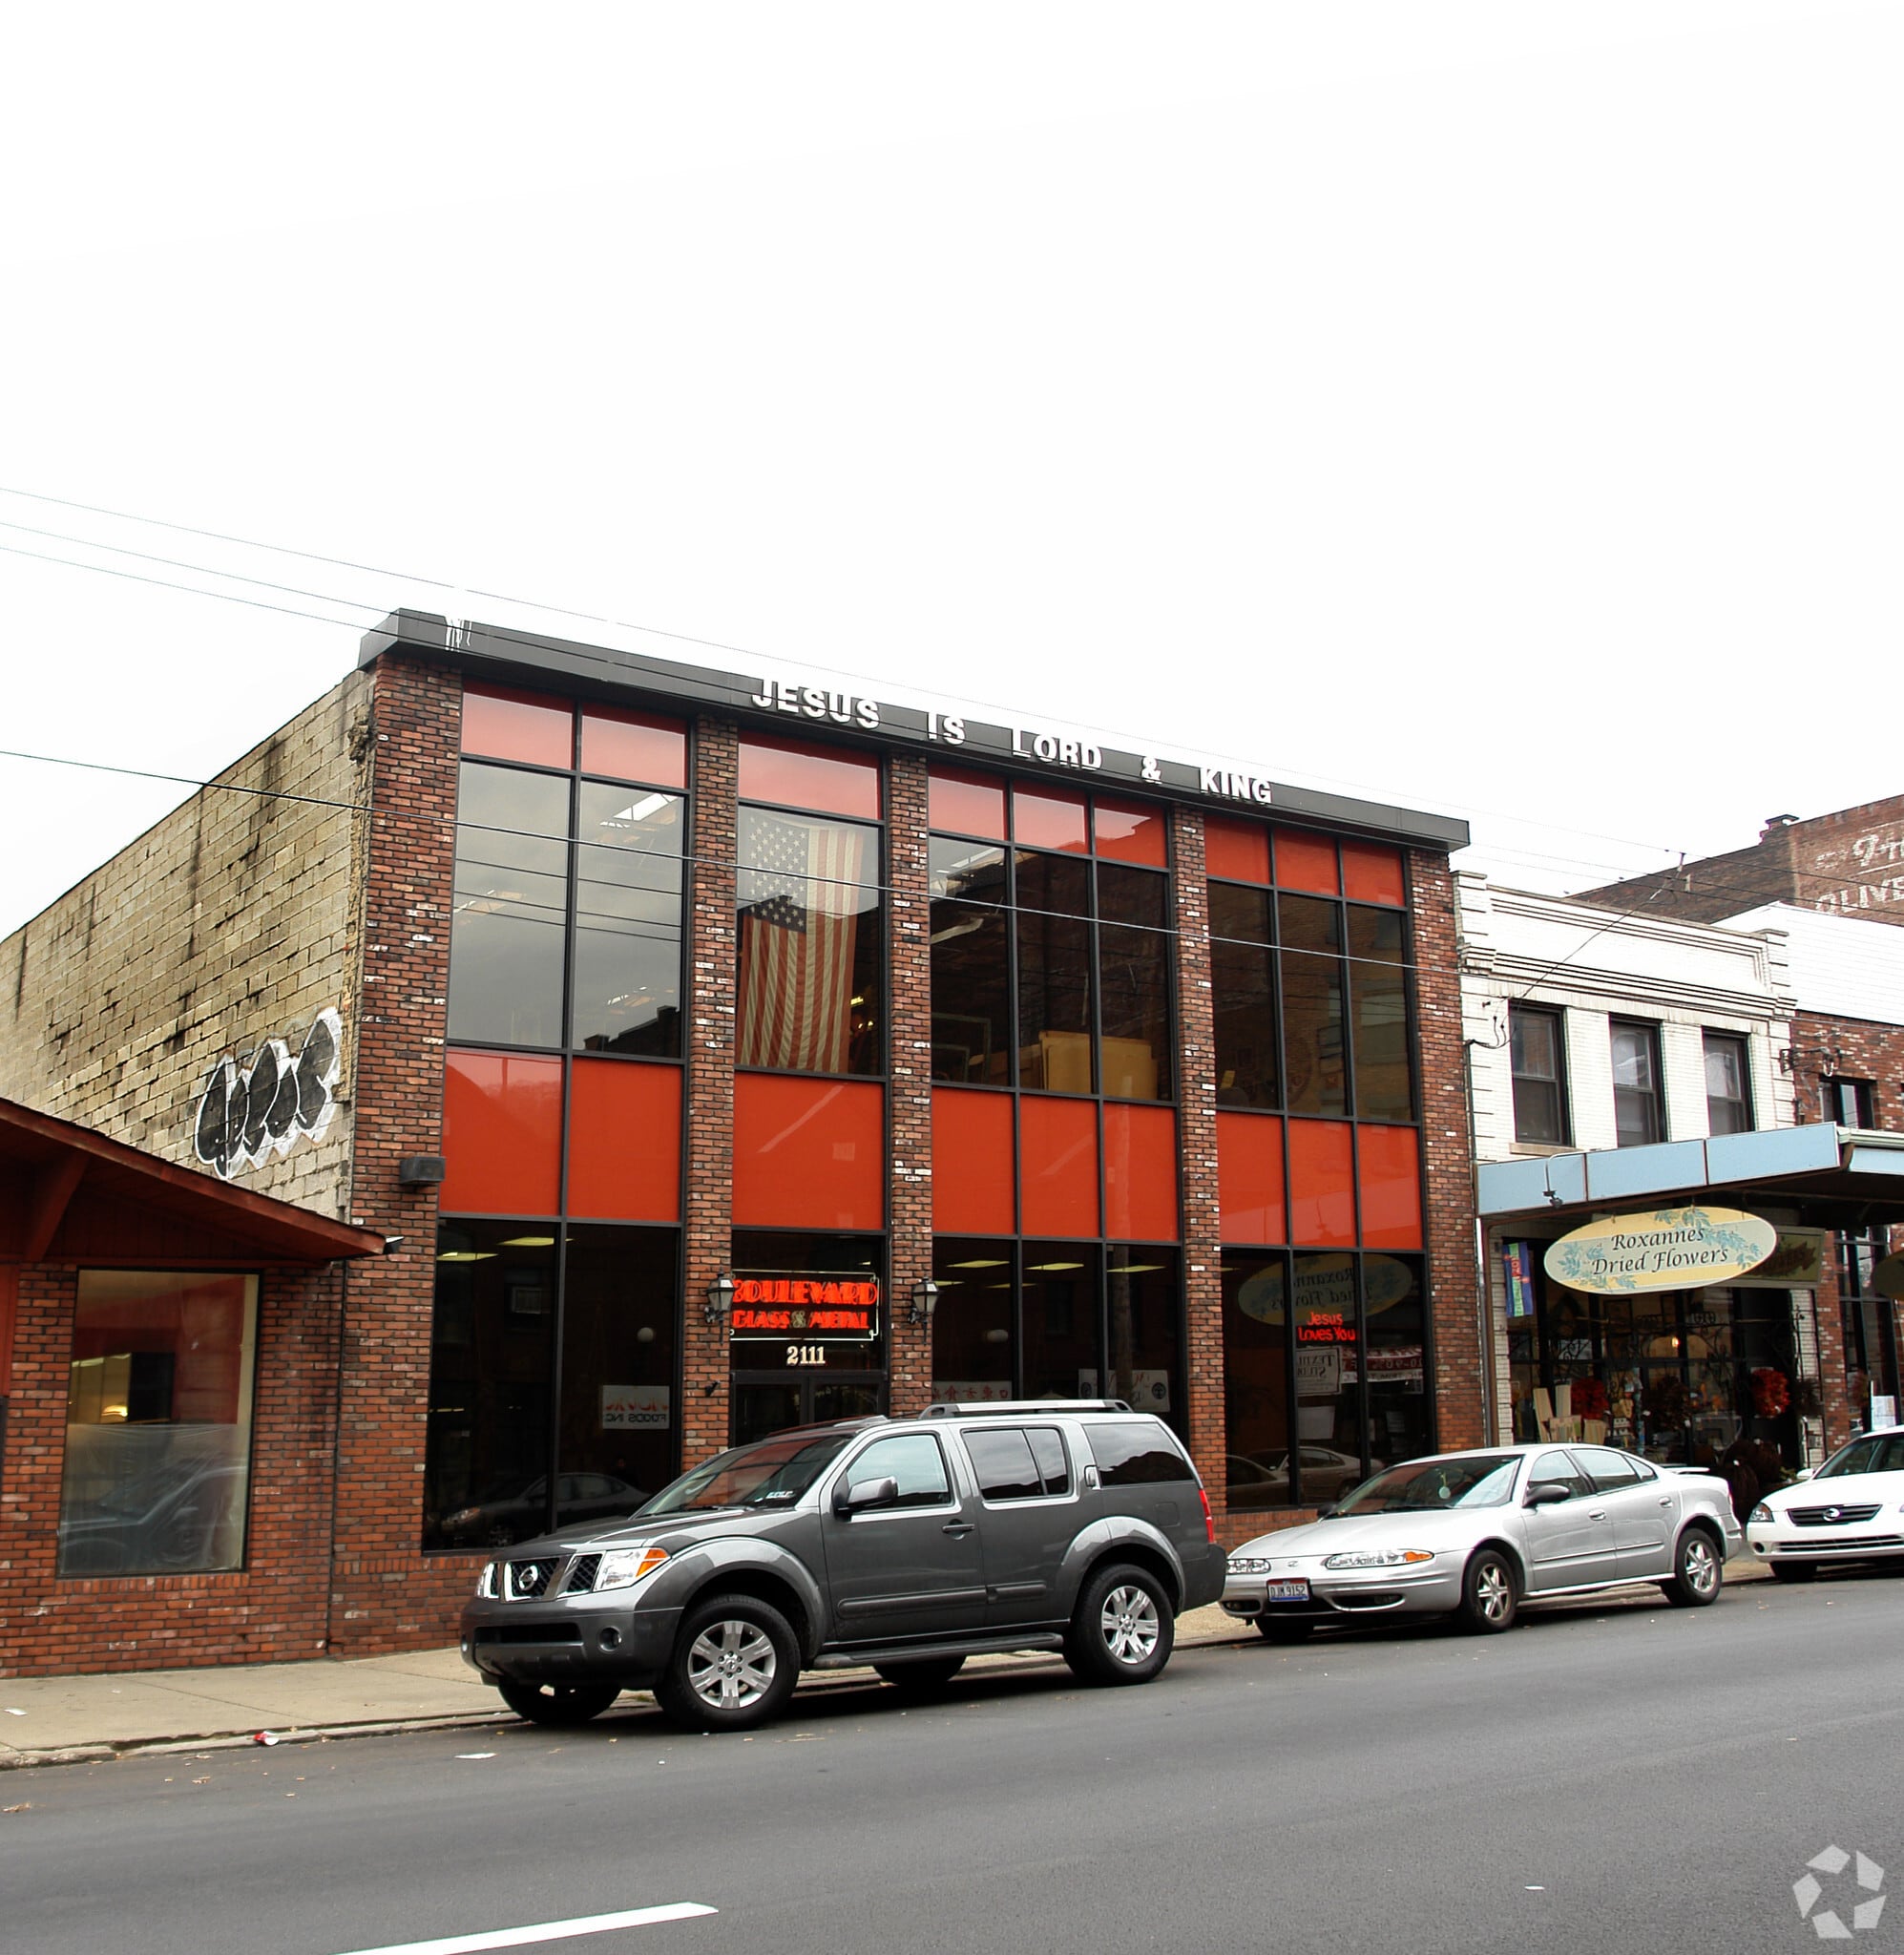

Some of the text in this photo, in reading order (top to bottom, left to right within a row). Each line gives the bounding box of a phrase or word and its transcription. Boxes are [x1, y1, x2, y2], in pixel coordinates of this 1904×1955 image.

[751, 680, 1273, 805] JESUS IS LORD & KING
[1611, 1227, 1705, 1251] Roxannes
[1592, 1246, 1728, 1275] Dried Flowers
[731, 1279, 877, 1306] BOULEVARD
[732, 1310, 869, 1329] GLASS & METAL
[1307, 1312, 1343, 1326] Jesus
[1298, 1327, 1355, 1341] Loves You
[786, 1345, 826, 1366] 2111
